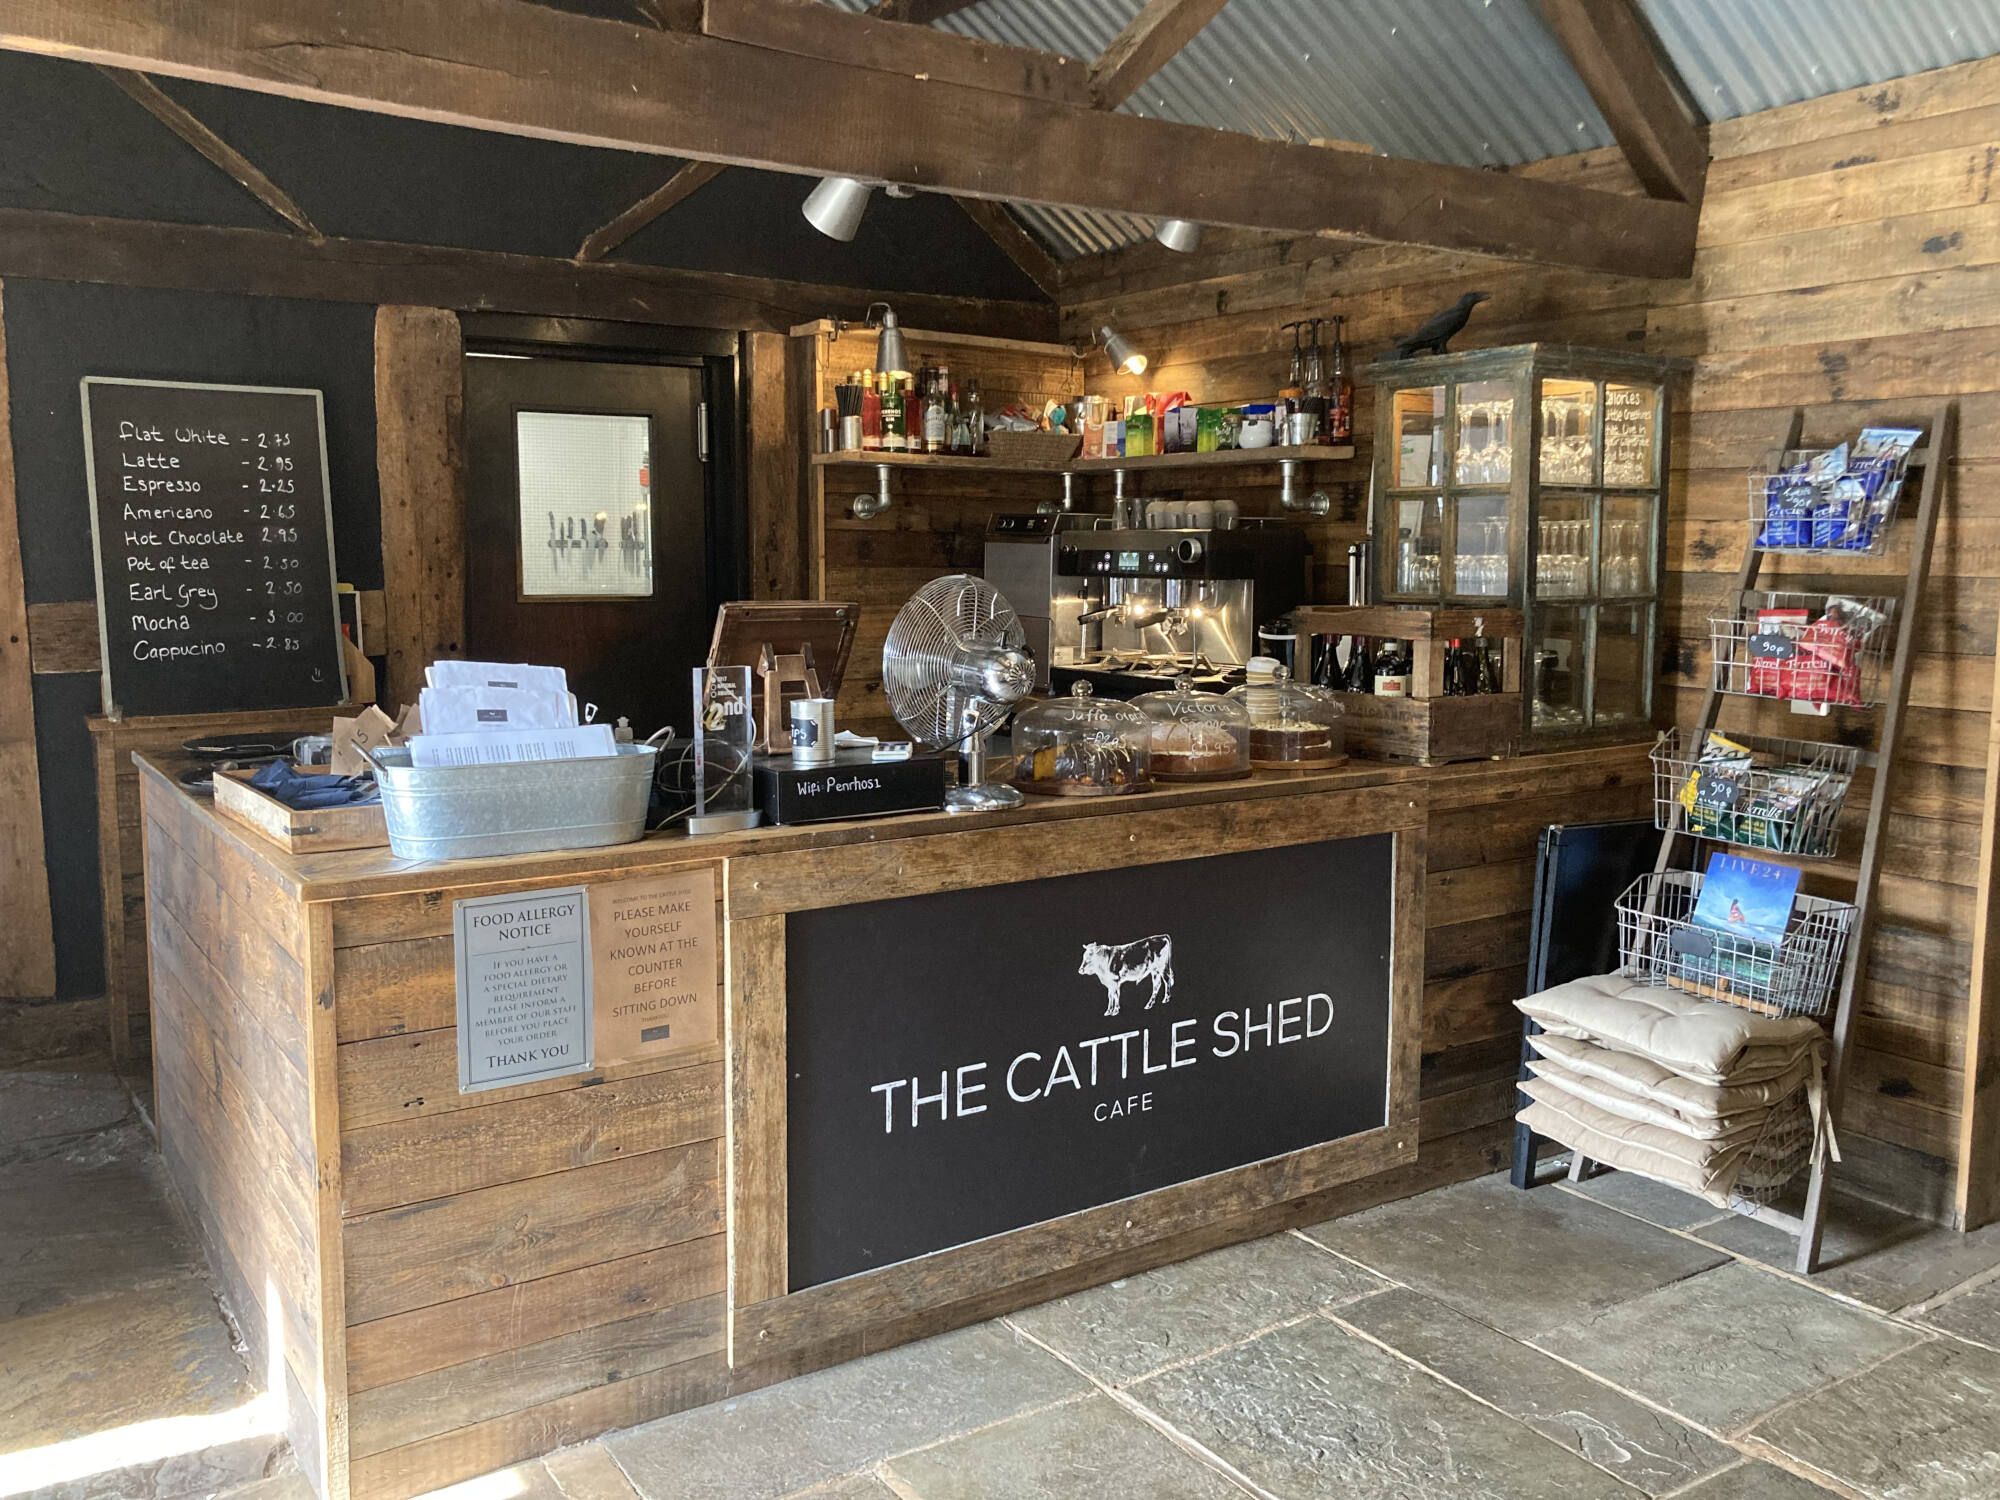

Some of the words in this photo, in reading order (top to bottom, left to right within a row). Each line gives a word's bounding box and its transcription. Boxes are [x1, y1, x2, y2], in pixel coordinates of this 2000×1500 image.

[119, 421, 164, 443] Flat
[175, 428, 230, 446] White
[258, 433, 291, 448] 2.75
[122, 452, 180, 469] Latte
[258, 457, 294, 471] 2.95
[123, 476, 200, 496] Espresso
[259, 479, 295, 493] 2.25
[124, 503, 213, 521] Americano
[260, 504, 295, 520] 2.65
[125, 531, 161, 546] Hot
[169, 529, 244, 545] Chocolate
[262, 527, 297, 543] 2.95
[127, 557, 155, 571] Pot
[160, 557, 175, 573] of
[180, 556, 210, 570] tea
[263, 556, 299, 569] 2.50
[130, 583, 173, 601] Earl
[176, 587, 218, 610] Grey
[266, 581, 302, 595] 2.50
[132, 614, 190, 631] Mocha
[133, 640, 226, 663] Cappucino
[1762, 641, 1785, 655] 90p
[1064, 709, 1110, 722] Jaffa
[1167, 702, 1231, 717] Victoria
[826, 776, 881, 792] Penrhos1
[473, 912, 514, 928] FOOD
[517, 904, 575, 921] ALLERGY
[614, 906, 655, 922] PLEASE
[658, 901, 692, 915] MAKE
[499, 923, 551, 941] NOTICE
[624, 921, 682, 938] YOURSELF
[610, 943, 656, 960] KNOWN
[660, 940, 674, 953] AT
[675, 936, 699, 949] THE
[504, 959, 524, 968] YOU
[527, 955, 549, 965] HAVE
[552, 953, 558, 961] A
[628, 958, 683, 976] COUNTER
[484, 971, 511, 982] FOOD
[513, 964, 552, 978] ALLERGY
[554, 963, 568, 972] OR
[492, 980, 528, 992] SPECIAL
[530, 973, 568, 987] DIETARY
[634, 976, 678, 994] BEFORE
[494, 986, 560, 1002] REQUIREMENT
[487, 1004, 518, 1015] PLEASE
[521, 997, 557, 1009] INFORM
[612, 1000, 656, 1017] SITTING
[660, 993, 697, 1009] DOWN
[475, 1015, 514, 1028] MEMBER
[516, 1013, 528, 1021] OF
[530, 1010, 550, 1019] OUR
[552, 1005, 577, 1015] STAFF
[485, 1025, 518, 1038] BEFORE
[520, 1022, 540, 1032] YOU
[543, 1017, 569, 1027] PLACE
[498, 1035, 524, 1046] YOUR
[526, 1030, 557, 1041] ORDER
[486, 1049, 538, 1068] THANK
[540, 1044, 569, 1059] YOU
[871, 1062, 987, 1133] THE
[1006, 1018, 1198, 1102] CATTLE
[1212, 993, 1334, 1058] SHED
[1094, 1092, 1153, 1122] CAFE
